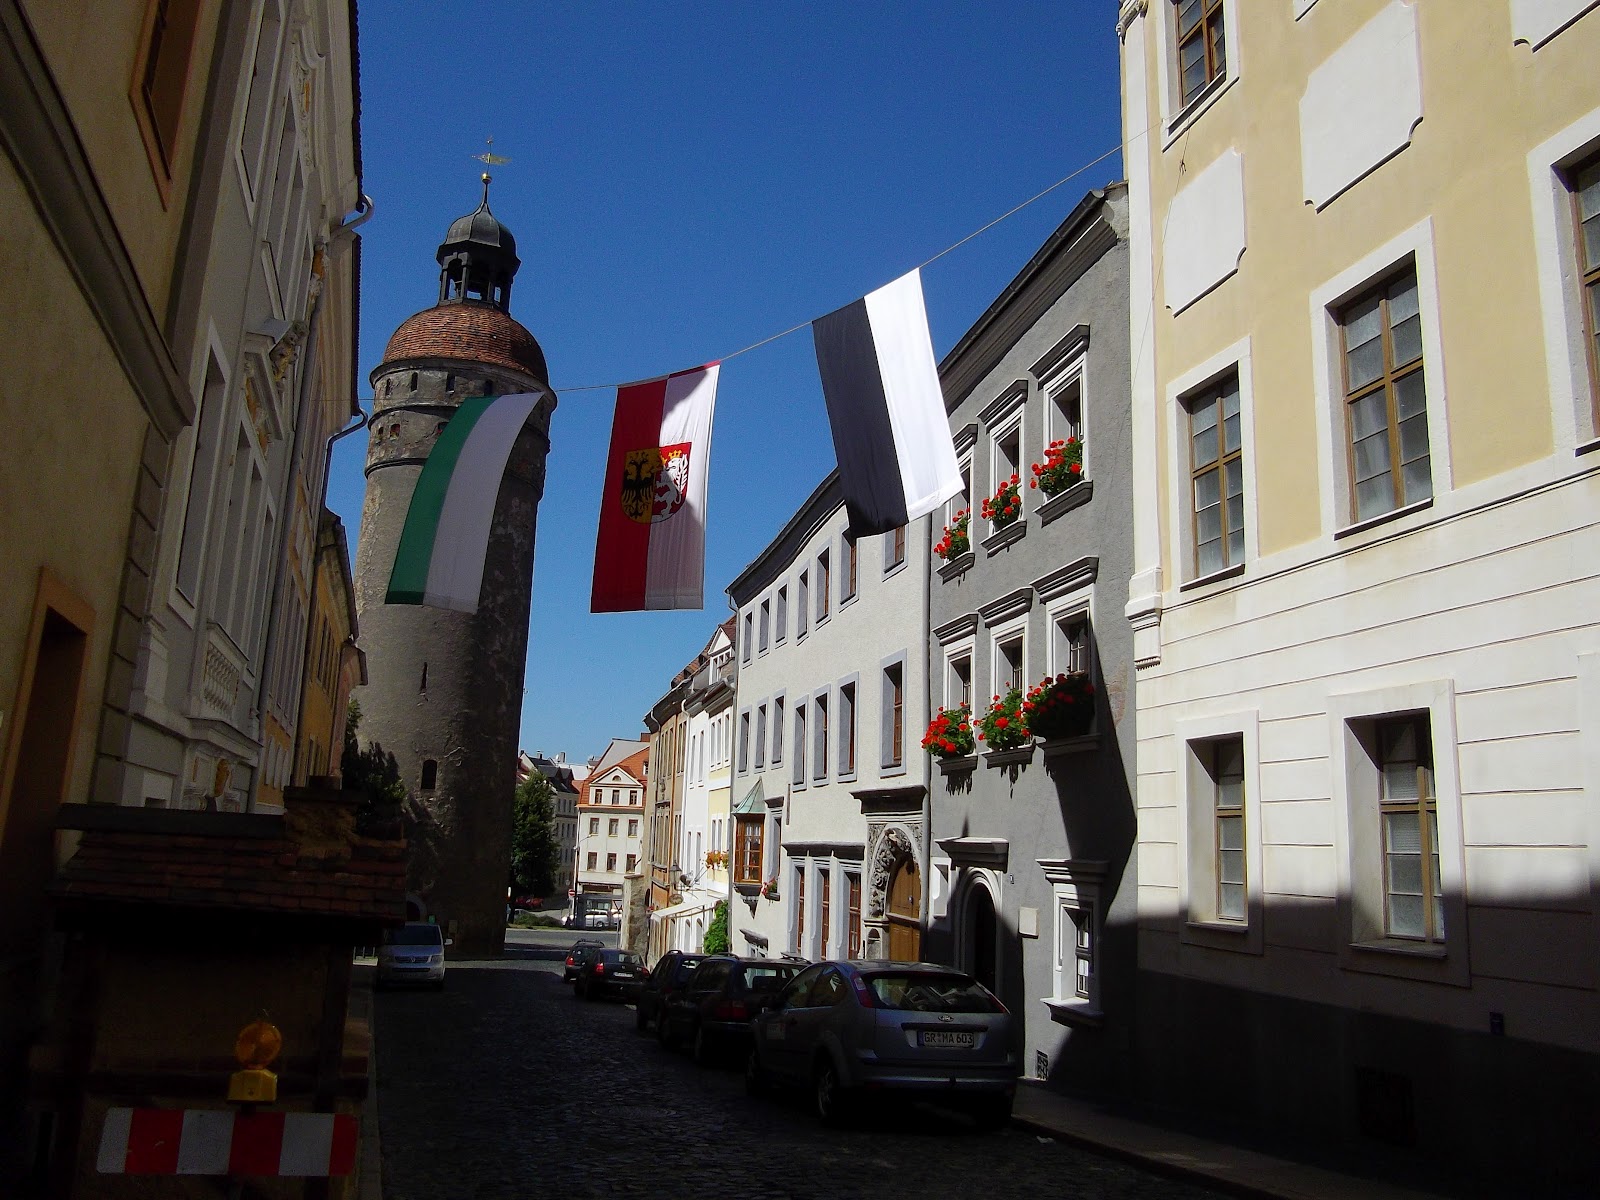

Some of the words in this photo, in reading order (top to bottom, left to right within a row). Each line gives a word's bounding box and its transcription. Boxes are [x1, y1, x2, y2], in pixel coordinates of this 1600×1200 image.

[925, 1032, 936, 1043] GR
[942, 1033, 955, 1044] MA
[956, 1034, 973, 1044] 603
